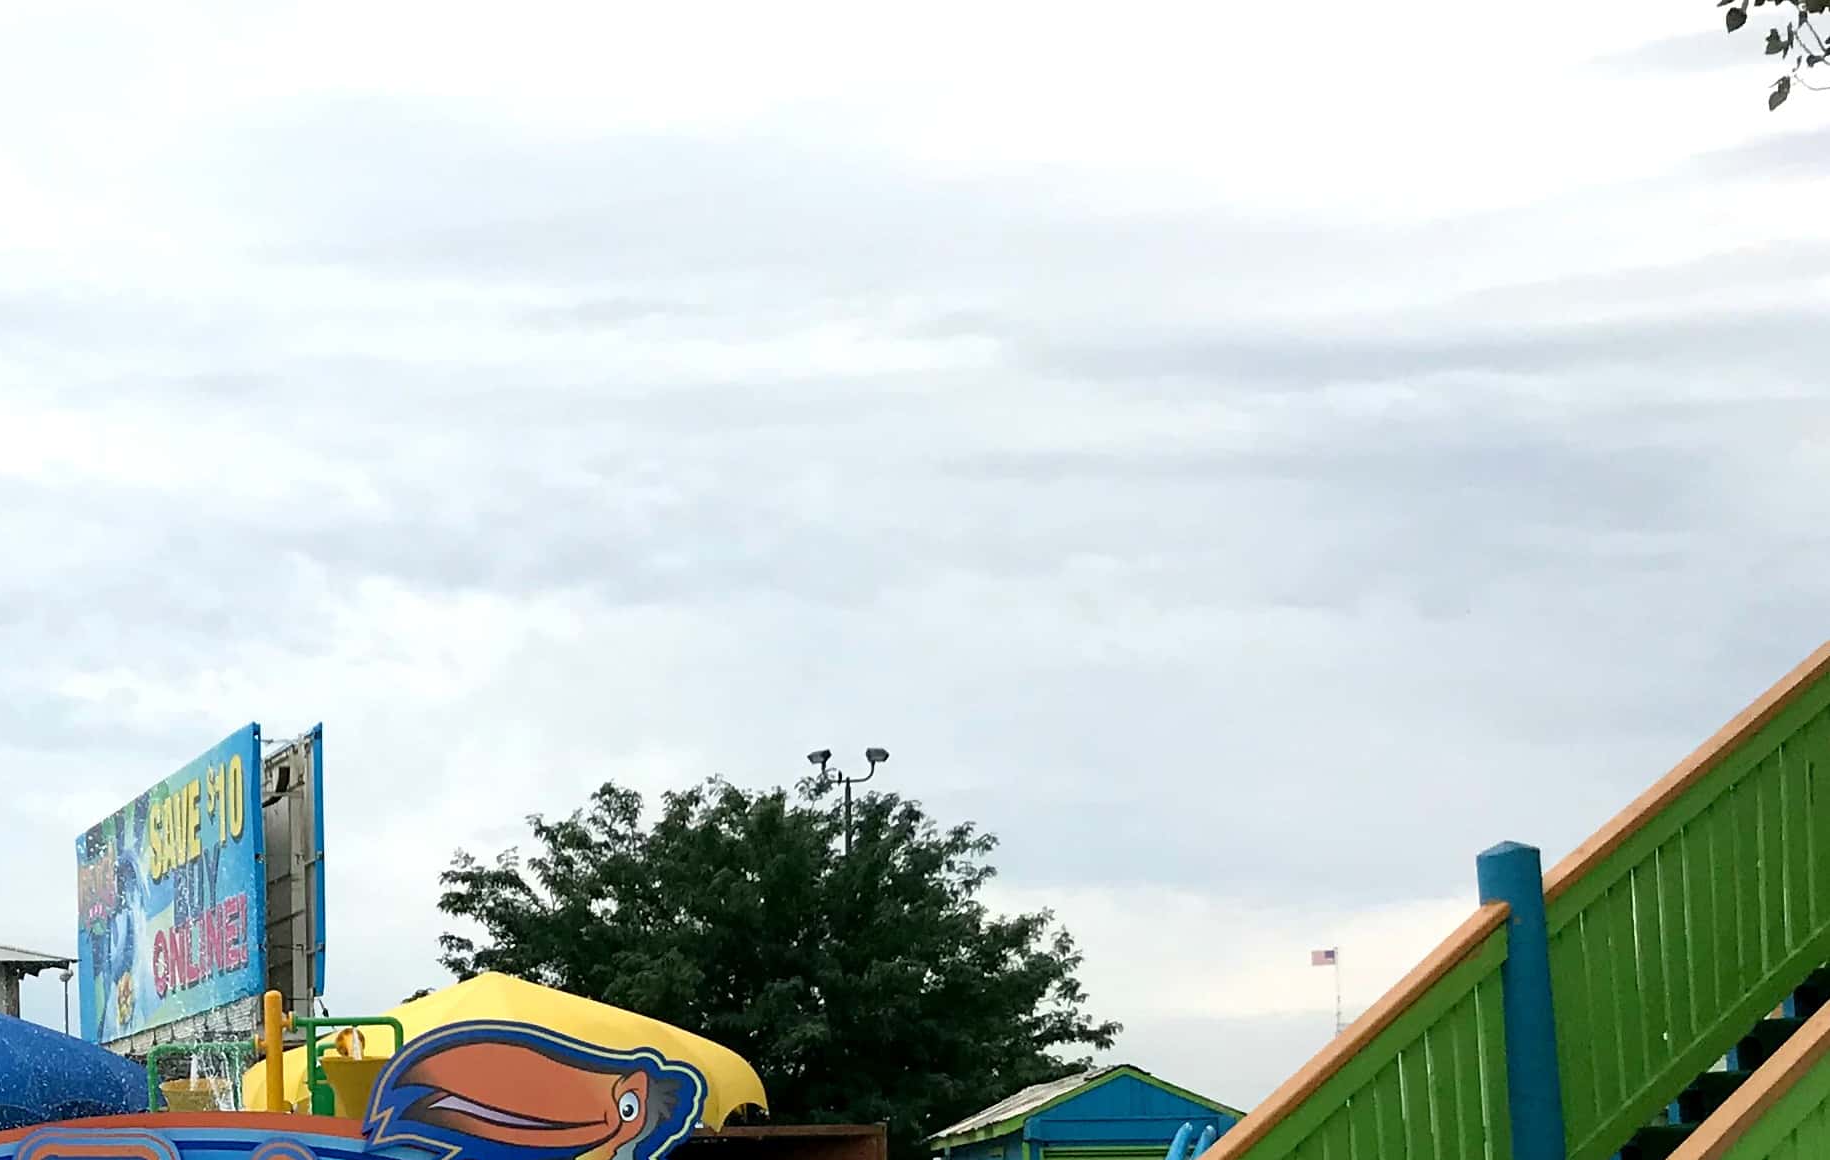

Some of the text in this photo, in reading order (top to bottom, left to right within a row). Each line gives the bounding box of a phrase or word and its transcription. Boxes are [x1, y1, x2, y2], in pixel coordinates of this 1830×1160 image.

[149, 780, 201, 880] SAVE
[206, 754, 244, 844] $10
[173, 846, 220, 931] BUY
[153, 893, 249, 998] ONLINE!
